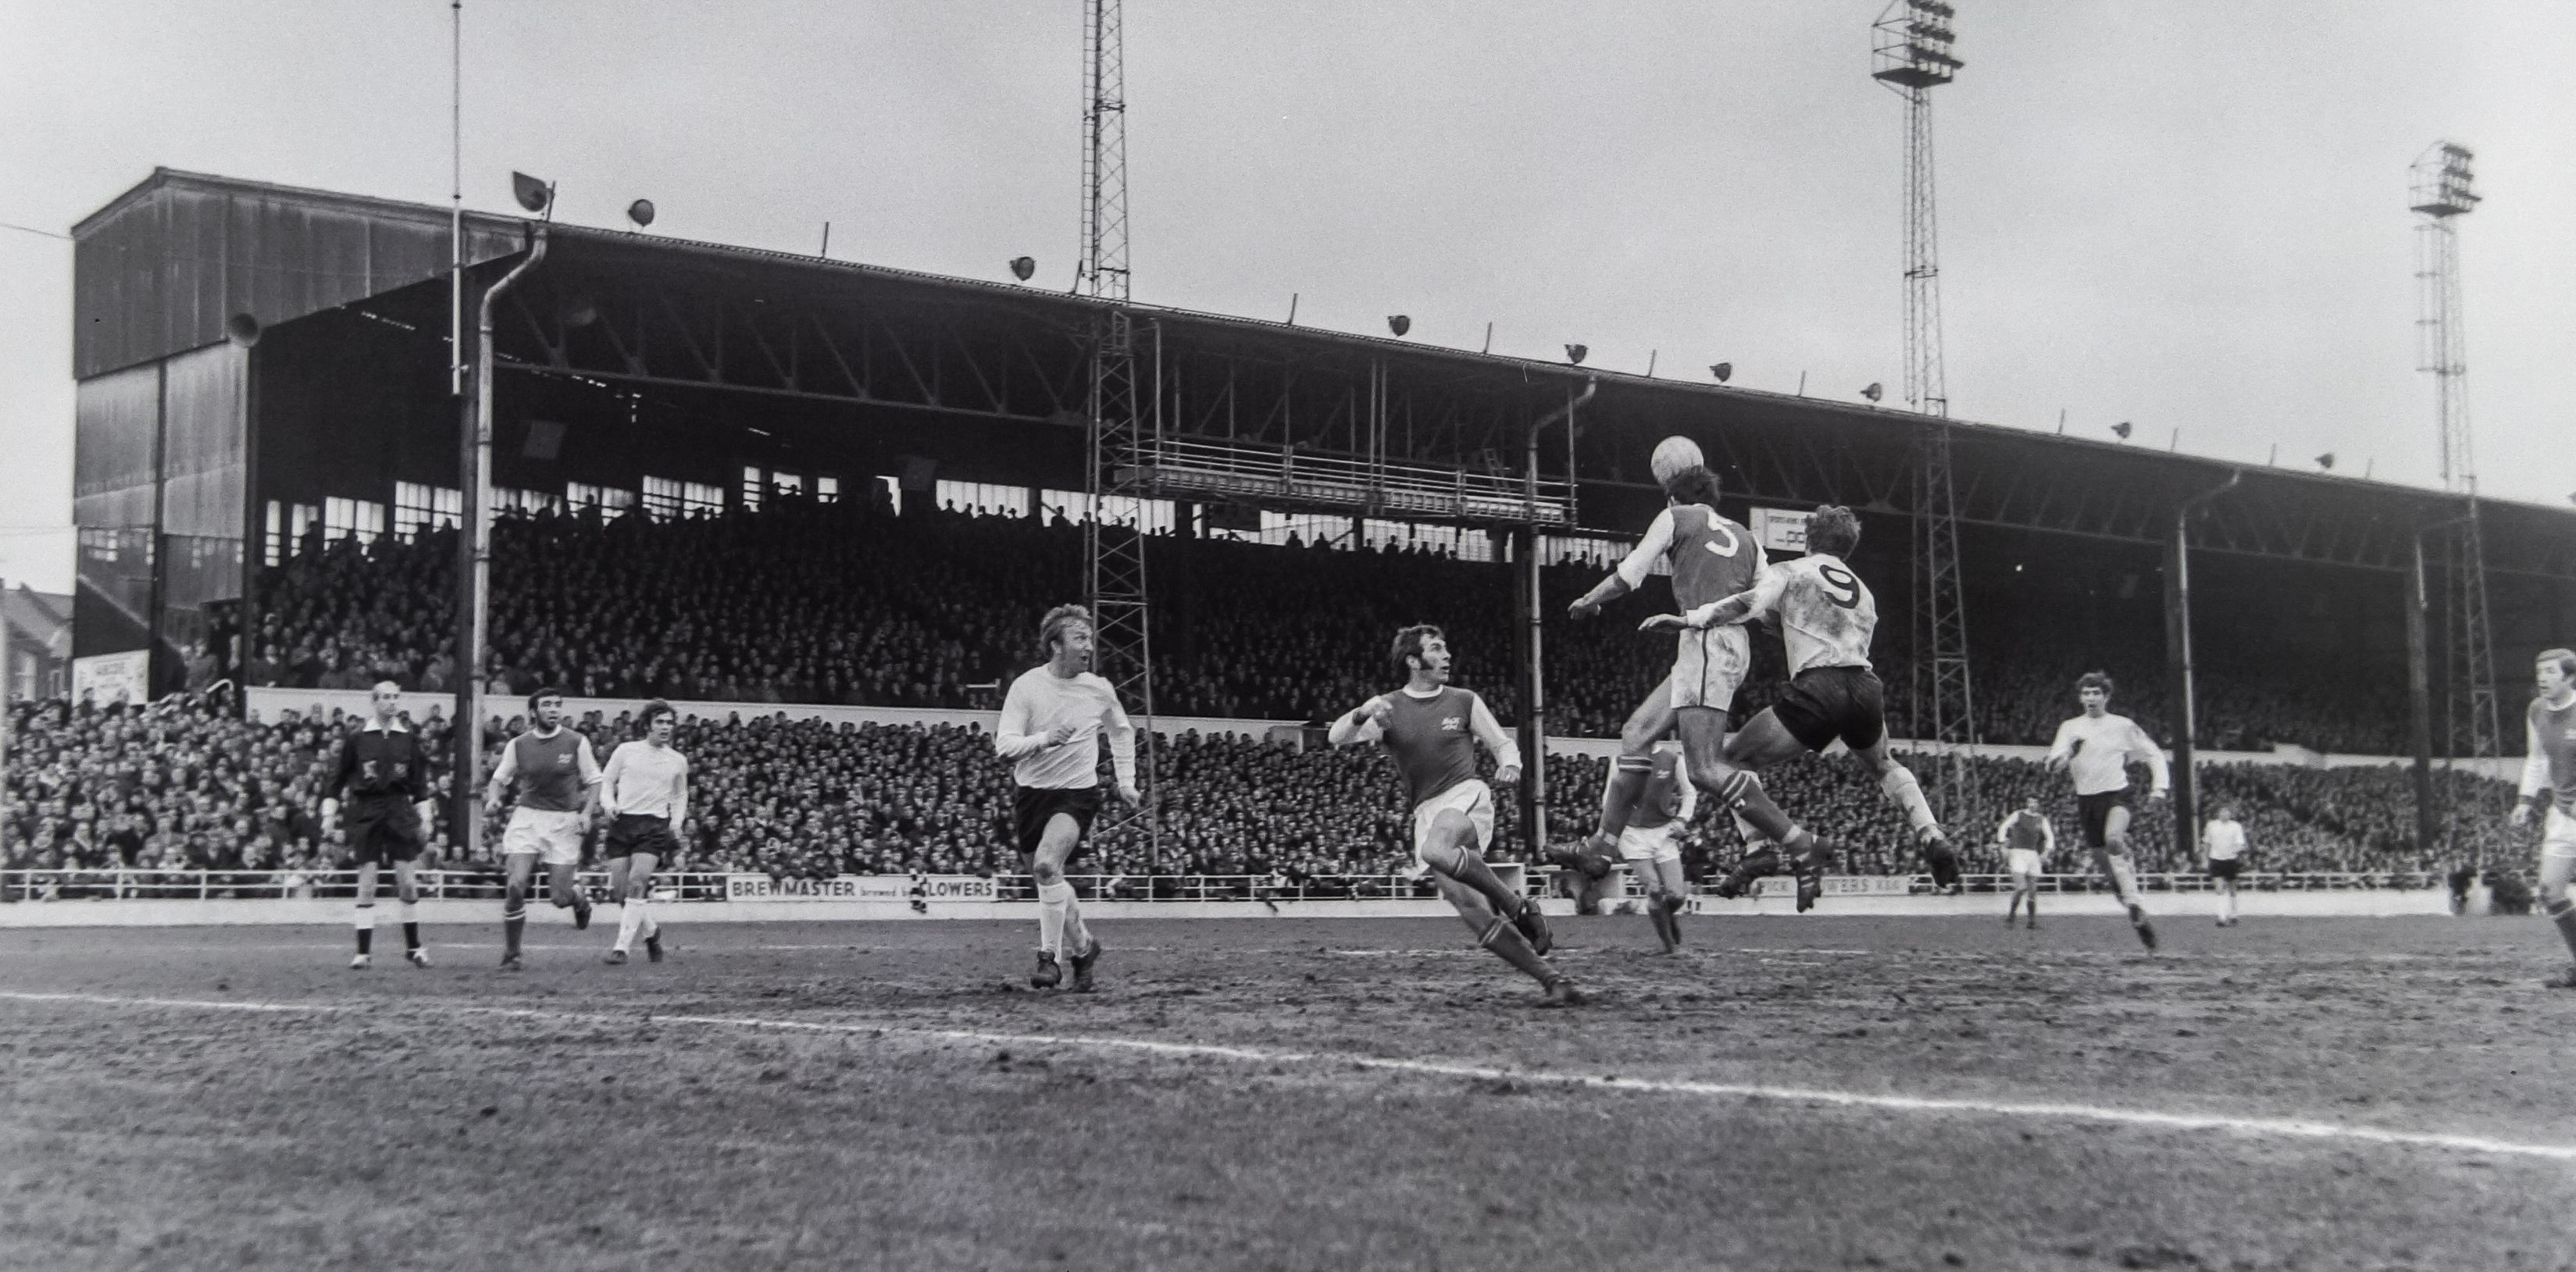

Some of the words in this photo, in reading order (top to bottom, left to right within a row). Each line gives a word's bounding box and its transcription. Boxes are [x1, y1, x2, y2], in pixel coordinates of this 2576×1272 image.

[1704, 511, 1739, 558] 5
[1819, 564, 1861, 610] 9
[732, 880, 855, 896] BREWMASTER
[926, 882, 993, 897] LOWERS
